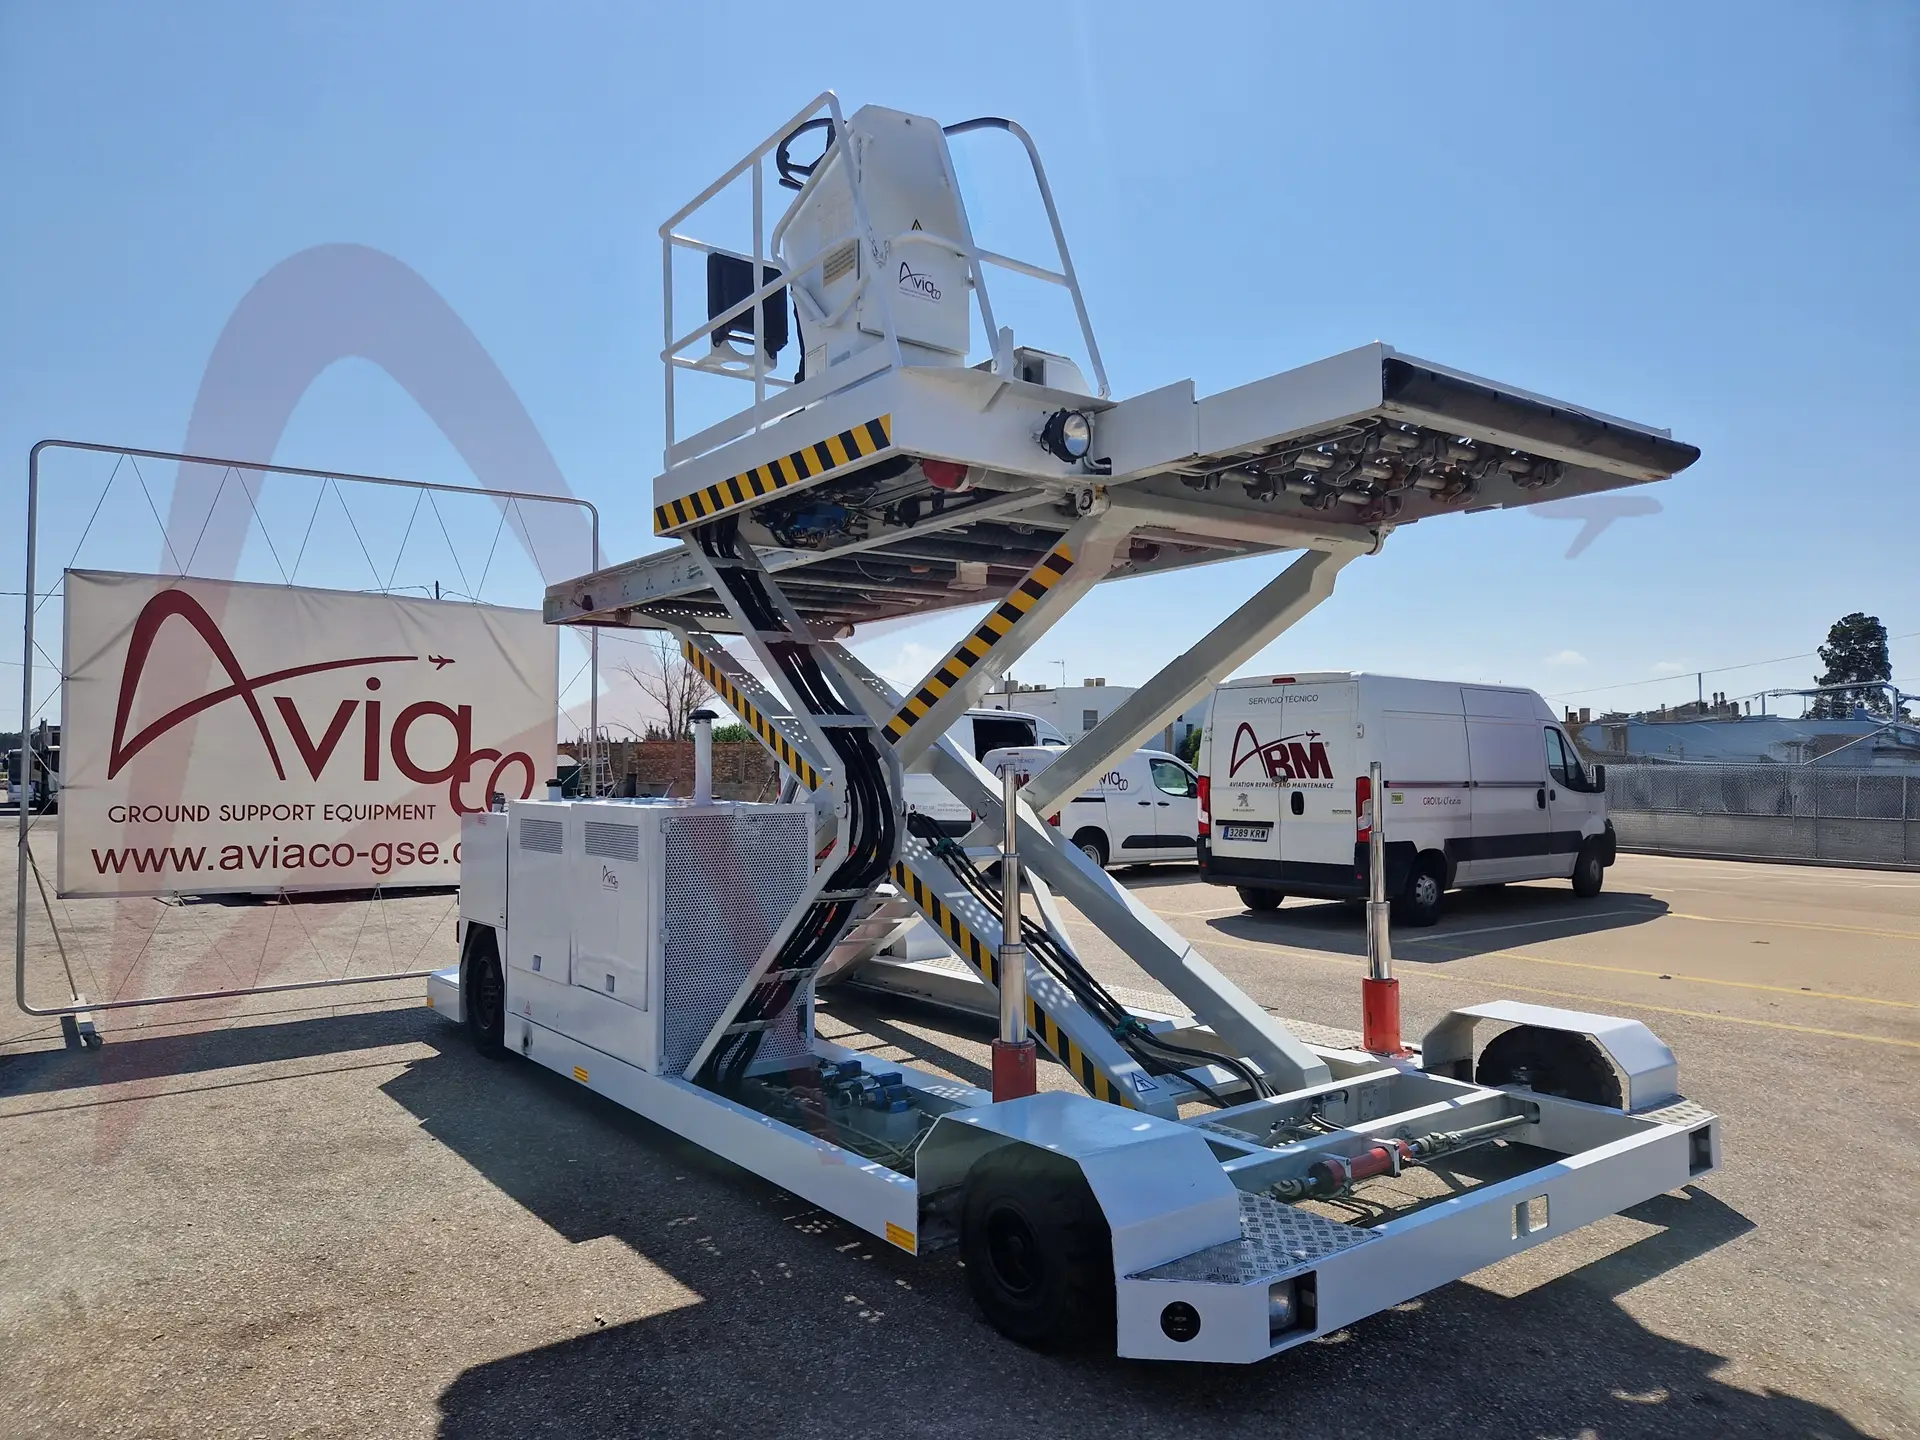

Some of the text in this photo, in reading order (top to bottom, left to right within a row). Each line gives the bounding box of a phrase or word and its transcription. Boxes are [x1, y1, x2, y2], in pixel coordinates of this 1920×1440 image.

[108, 589, 536, 817] Aviaco
[1248, 694, 1319, 705] SERVICIO TÉCNICO
[1229, 722, 1334, 779] ARM
[108, 803, 437, 823] GROUND SUPPORT EQUIPMENT
[1229, 828, 1248, 838] 3289
